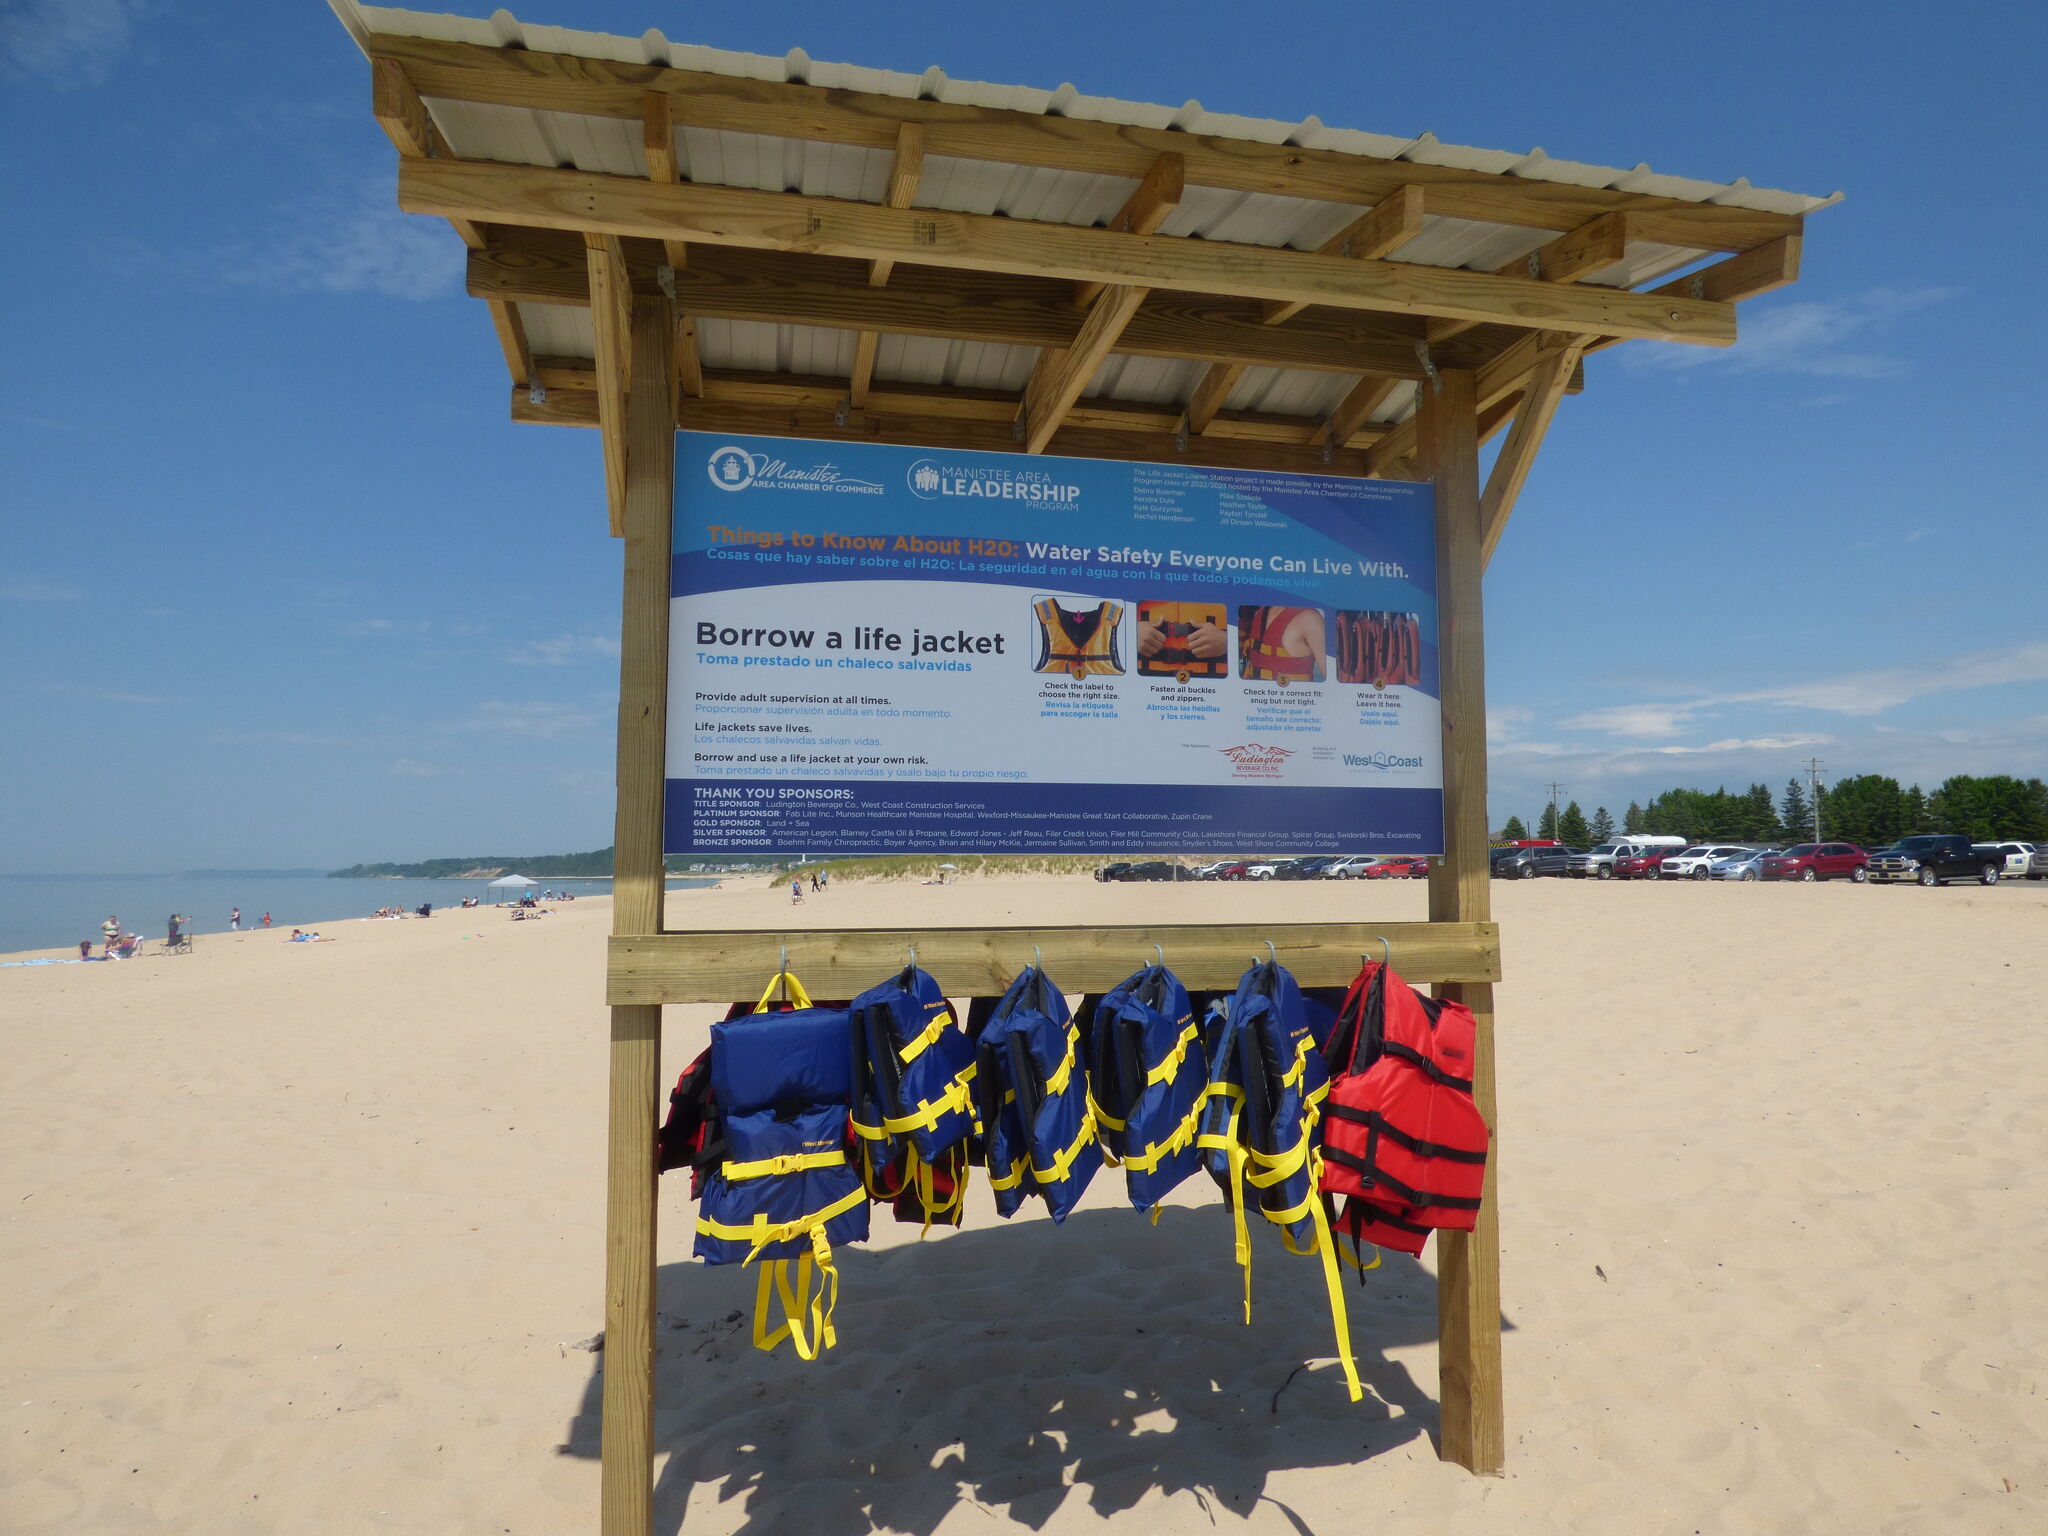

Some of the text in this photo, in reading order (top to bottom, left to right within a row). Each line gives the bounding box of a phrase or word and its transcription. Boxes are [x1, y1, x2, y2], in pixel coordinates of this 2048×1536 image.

[746, 454, 858, 482] Manistee
[942, 466, 1052, 483] MANISTEE AREA
[751, 479, 775, 488] AREA
[777, 481, 819, 490] CHAMBER
[835, 484, 883, 494] COMMERCE
[942, 478, 1080, 501] LEADERSHIP
[1026, 500, 1079, 511] PROGRAM
[707, 526, 784, 548] Things
[792, 532, 816, 548] to
[824, 534, 886, 550] Know
[894, 535, 961, 555] About
[1026, 542, 1090, 561] Water
[1097, 546, 1162, 567] Safety
[1170, 550, 1262, 570] Everyone
[1269, 556, 1306, 572] Can
[1313, 558, 1352, 575] Live
[1358, 561, 1408, 578] With.
[707, 548, 749, 560] Cosas
[754, 552, 781, 563] que
[786, 551, 811, 565] hay
[816, 553, 855, 565] saber
[859, 556, 899, 567] sobre
[903, 557, 915, 568] el
[959, 560, 974, 570] La
[979, 562, 1046, 574] seguridad
[1050, 566, 1066, 575] en
[1070, 565, 1082, 576] el
[1086, 568, 1118, 578] agua
[1122, 570, 1145, 579] con
[1150, 569, 1160, 580] la
[1164, 572, 1188, 582] que
[1192, 571, 1228, 583] todos
[697, 622, 1004, 655] Borrow a life jacket
[696, 652, 971, 671] Toma prestado un chaleco salvavidas
[1078, 670, 1082, 678] 1
[1180, 672, 1187, 682] 2
[1280, 676, 1287, 686] 3
[1376, 679, 1383, 688] 4
[695, 692, 736, 701] Provide
[739, 693, 766, 701] adult
[770, 694, 829, 703] supervision
[845, 695, 857, 704] all
[860, 696, 891, 704] times.
[1038, 690, 1066, 698] choose
[1176, 694, 1205, 702] zippers.
[1297, 698, 1317, 706] tight.
[695, 704, 762, 713] Proporcionar
[826, 706, 858, 716] adulta
[876, 708, 899, 716] todo
[695, 722, 714, 731] Life
[717, 722, 755, 732] jackets
[785, 724, 812, 732] lives.
[694, 734, 712, 743] Los
[715, 734, 761, 743] chalecos
[764, 735, 816, 744] salvavidas
[819, 736, 850, 745] salvan
[694, 752, 733, 761] Borrow
[736, 753, 756, 761] and
[790, 754, 806, 762] life
[808, 754, 840, 764] jacket
[843, 755, 853, 763] at
[857, 757, 880, 765] your
[907, 756, 928, 764] risk.
[1342, 754, 1374, 766] West
[1388, 755, 1422, 767] Coast
[694, 787, 853, 799] THANK YOU SPONSORS:
[766, 800, 805, 808] Ludington
[807, 800, 843, 809] Beverage
